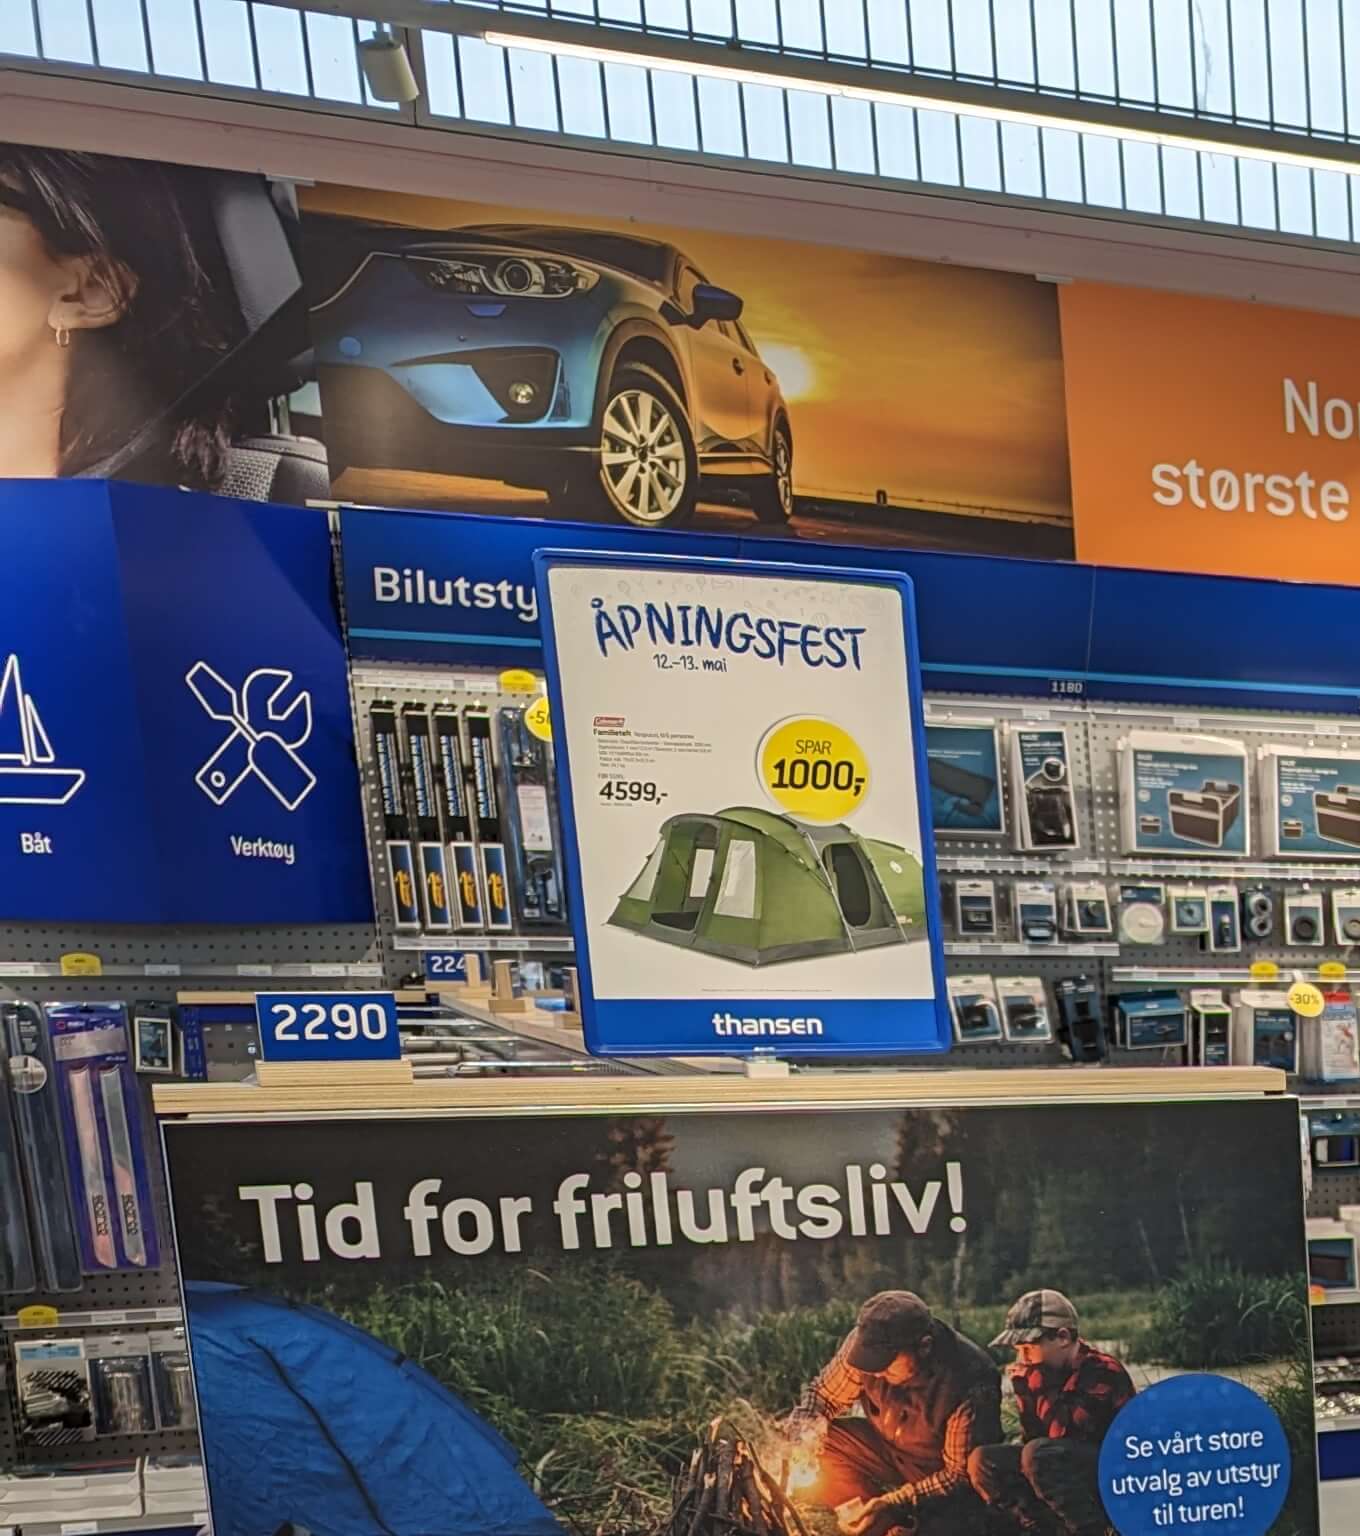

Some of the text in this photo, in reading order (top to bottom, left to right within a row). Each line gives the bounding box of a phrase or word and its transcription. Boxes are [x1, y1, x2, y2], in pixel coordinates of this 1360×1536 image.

[1151, 459, 1349, 522] største
[374, 566, 540, 622] Bilutsty
[591, 597, 867, 671] ÅPNINGSFEST
[702, 657, 728, 673] mai
[795, 740, 832, 755] SPAR
[771, 758, 865, 797] 1000,-
[599, 781, 669, 805] 4599,-
[21, 832, 52, 856] Båt
[231, 835, 295, 864] Verktøy
[432, 954, 466, 974] 224
[270, 1002, 388, 1042] 2290
[712, 1012, 824, 1036] thansen
[238, 1180, 380, 1265] Tid
[404, 1177, 531, 1256] for
[553, 1160, 968, 1250] friluftsliv!
[1126, 1430, 1263, 1459] Se vårt store
[1112, 1463, 1281, 1496] utvalg av utstyr
[1153, 1496, 1245, 1526] til turen!
